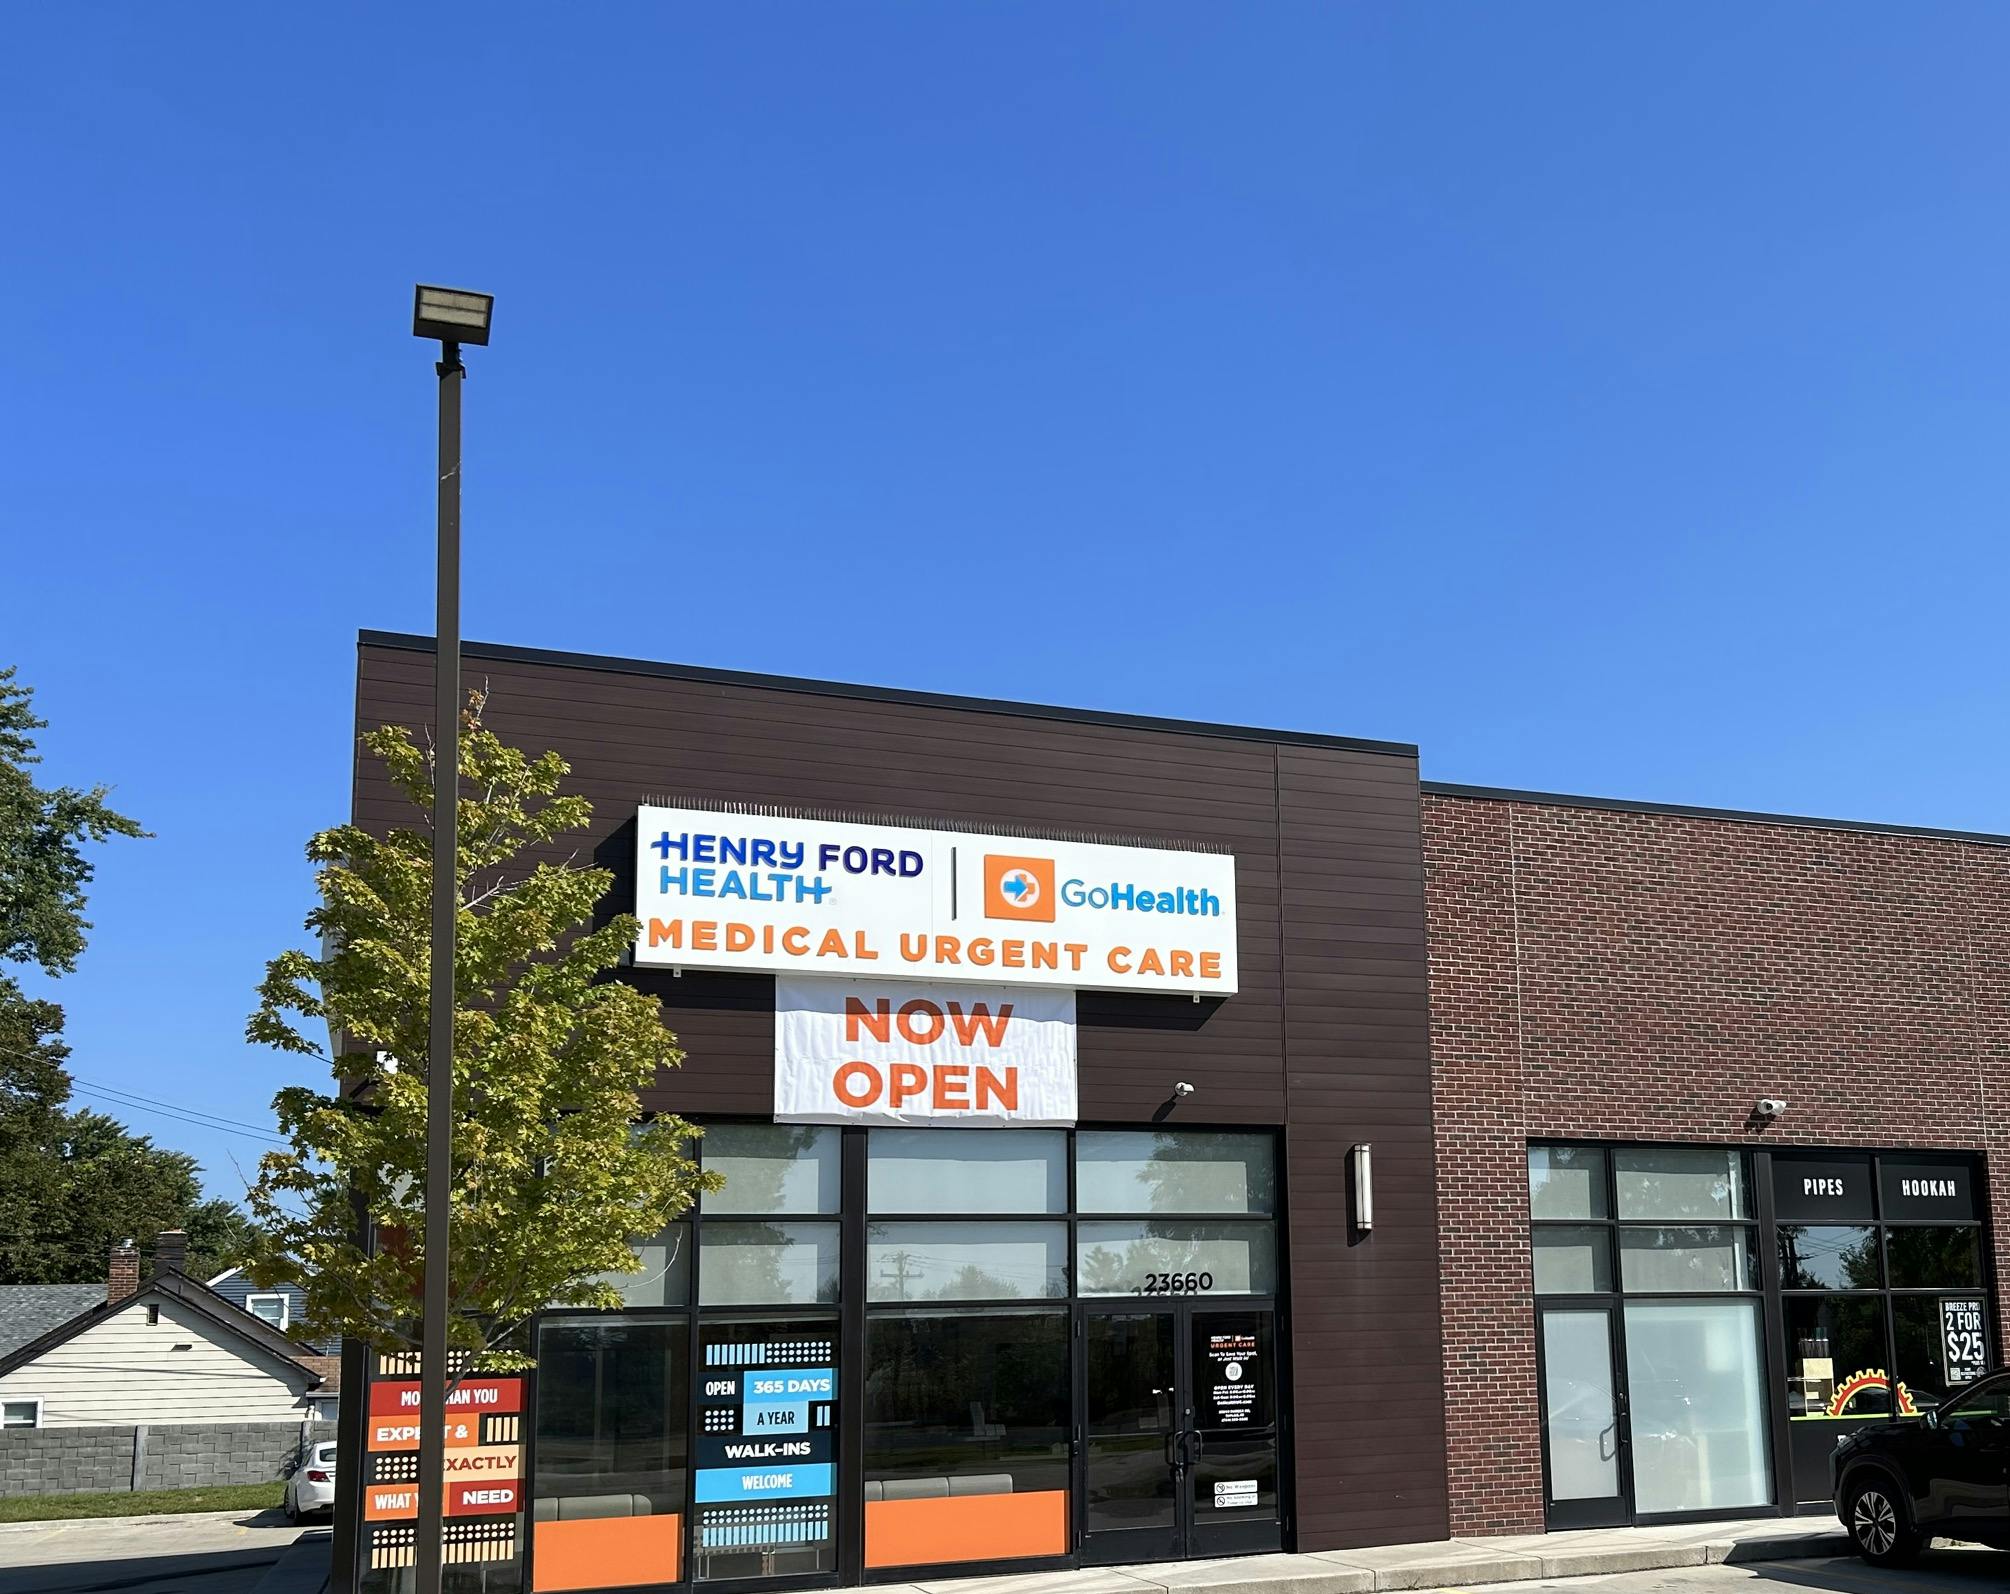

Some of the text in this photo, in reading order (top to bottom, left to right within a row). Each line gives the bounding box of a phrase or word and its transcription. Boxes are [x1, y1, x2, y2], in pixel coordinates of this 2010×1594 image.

[651, 831, 924, 878] HENRY FORD
[659, 865, 832, 904] HEALTH
[1061, 878, 1220, 917] GoHealth
[648, 917, 1222, 979] MEDICAL URGENT CARE
[845, 996, 1014, 1048] NOW
[832, 1061, 1018, 1111] OPEN
[1804, 1178, 1843, 1196] PIPES
[1902, 1179, 1956, 1197] HOOKAH
[1144, 1272, 1213, 1292] 23660
[1945, 1302, 1967, 1311] BREEZE
[1945, 1312, 1981, 1330] 2 FOR
[1947, 1331, 1985, 1362] $25
[474, 1388, 498, 1404] YOU
[705, 1378, 831, 1396] OPEN 365 DAYS
[757, 1411, 795, 1425] A YEAR
[455, 1424, 468, 1439] &
[725, 1441, 811, 1459] WALK-INS
[442, 1455, 517, 1471] XACTLY
[742, 1473, 793, 1490] WELCOME
[375, 1492, 411, 1510] WHAT
[462, 1489, 514, 1505] NEED
